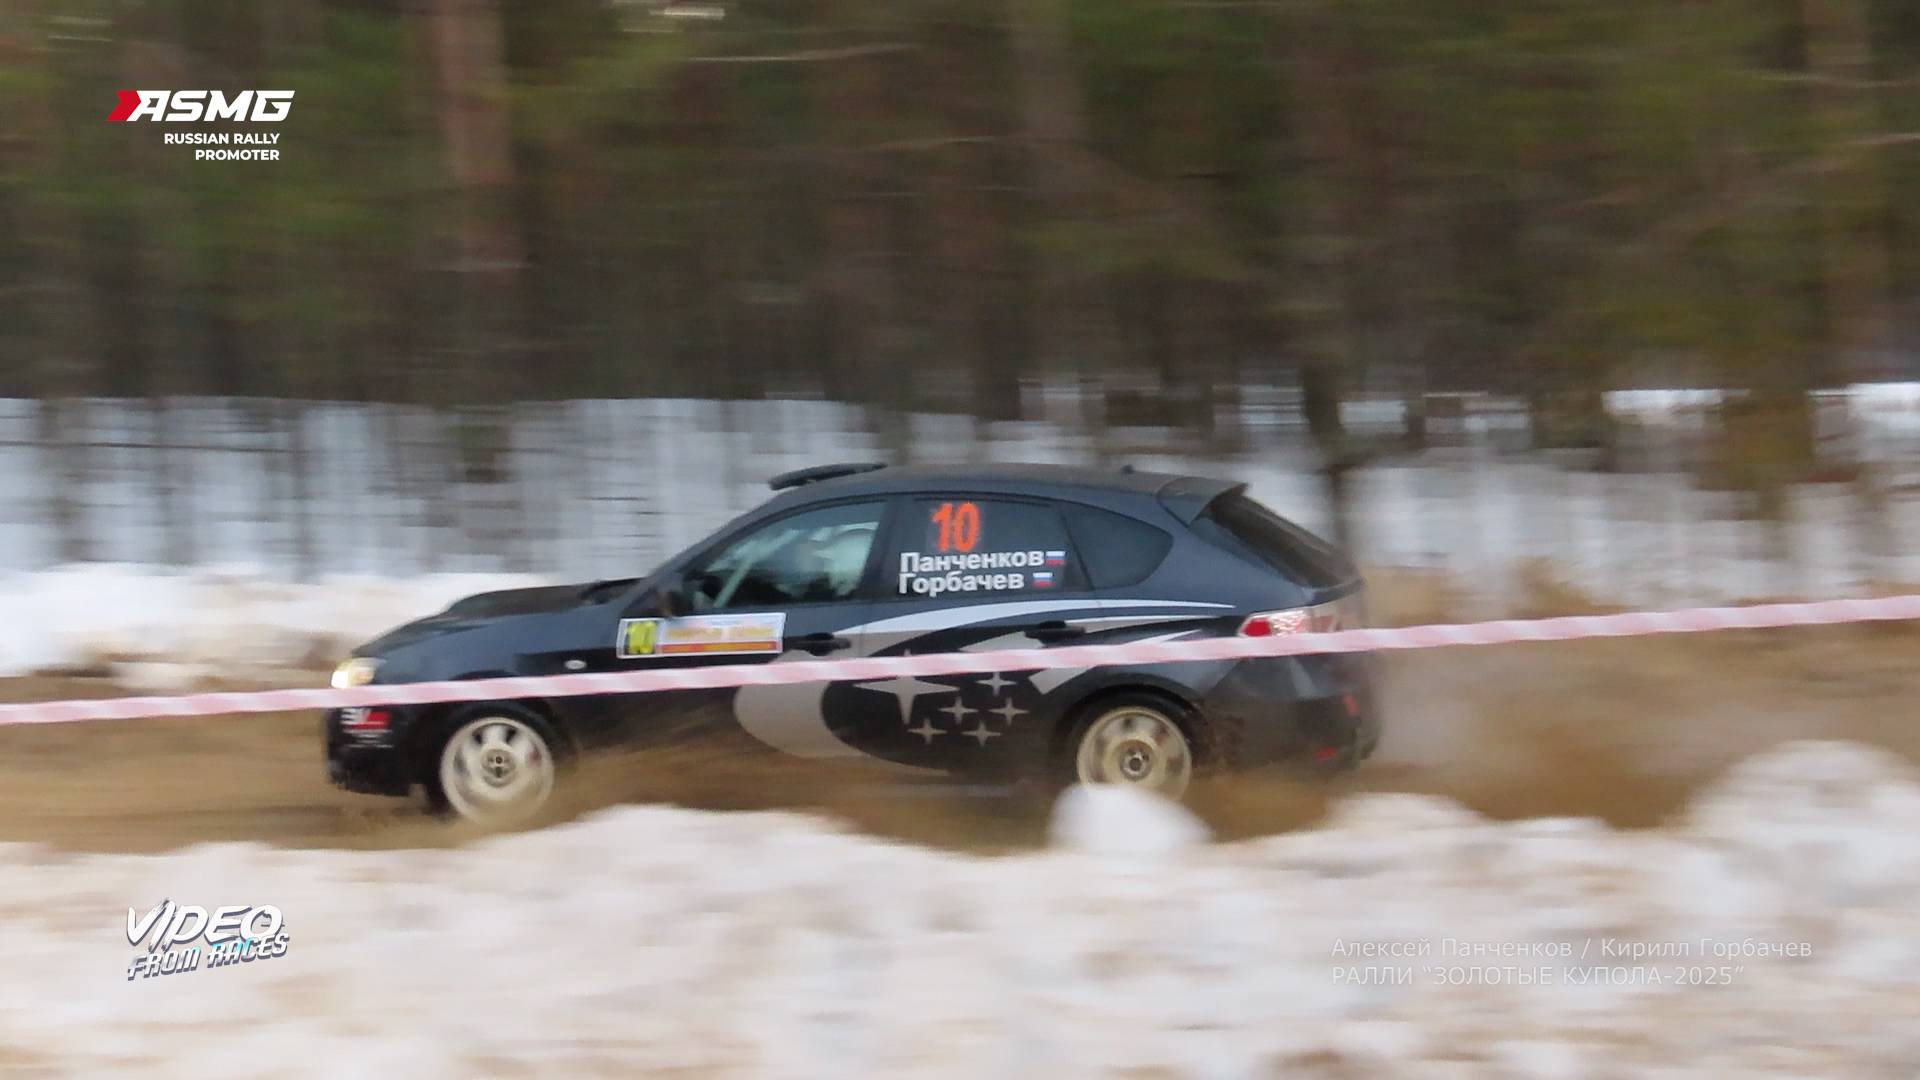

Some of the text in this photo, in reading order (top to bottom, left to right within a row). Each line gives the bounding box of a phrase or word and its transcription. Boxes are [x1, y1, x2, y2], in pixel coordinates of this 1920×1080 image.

[930, 502, 980, 552] 10
[900, 551, 1045, 573] Панченков
[898, 570, 1024, 597] Горбачев
